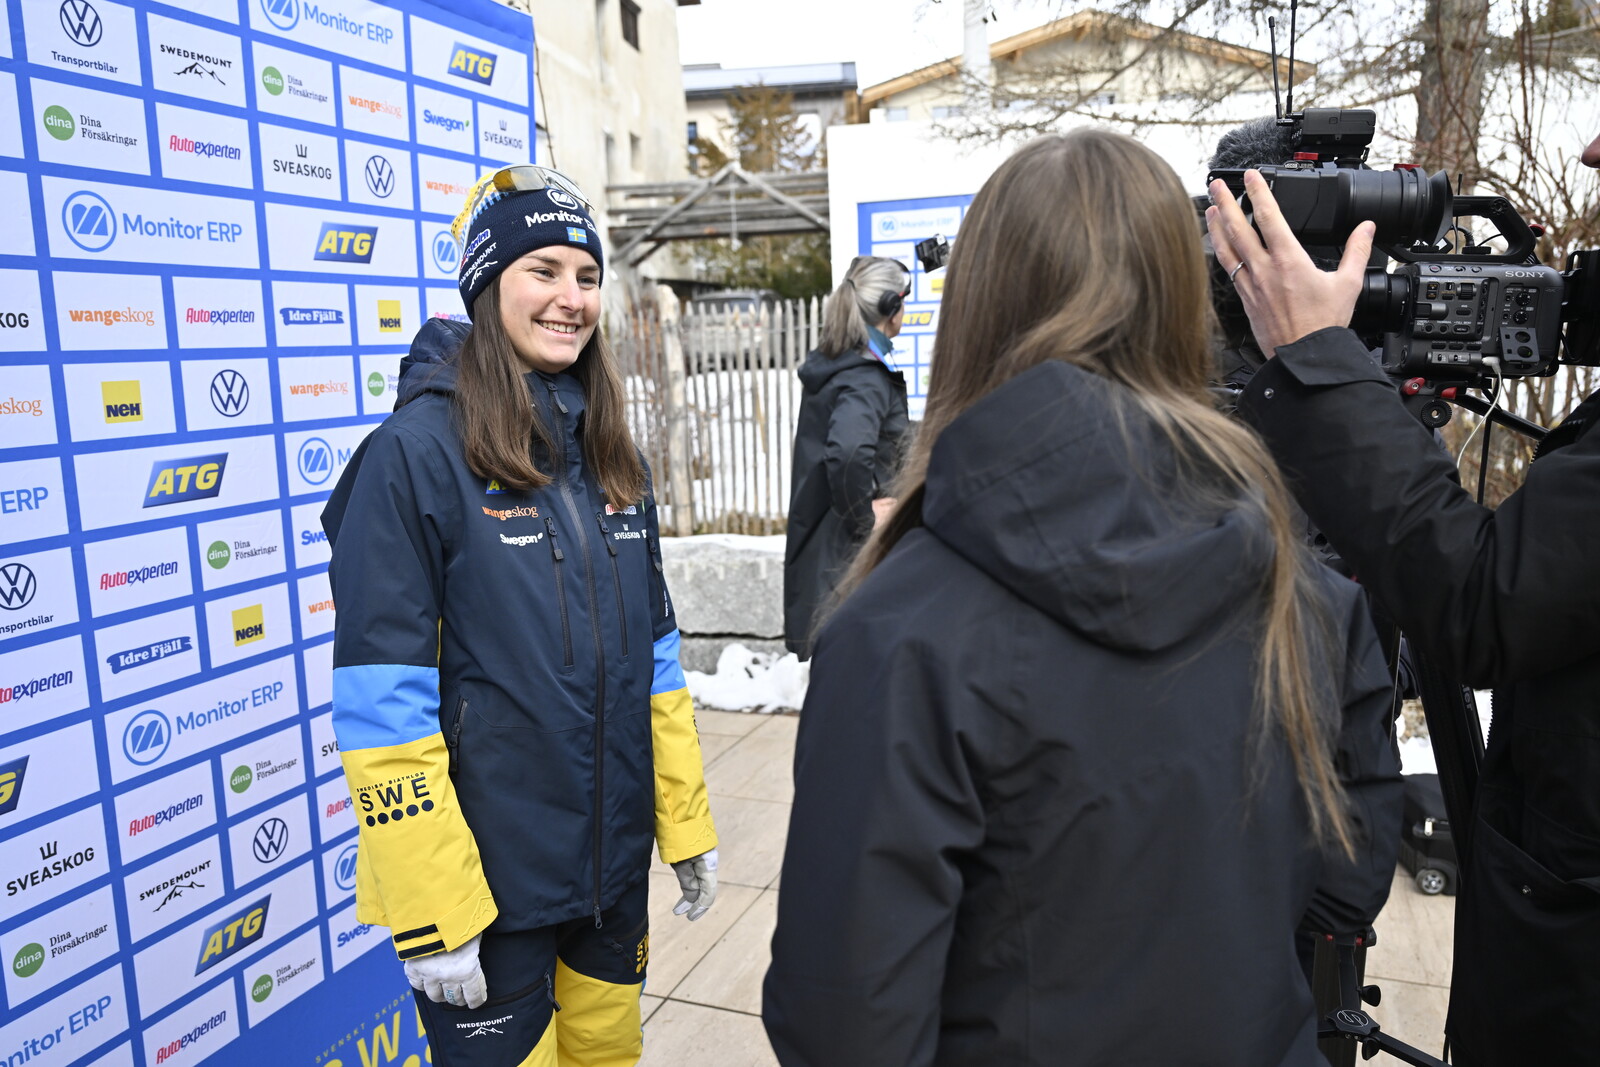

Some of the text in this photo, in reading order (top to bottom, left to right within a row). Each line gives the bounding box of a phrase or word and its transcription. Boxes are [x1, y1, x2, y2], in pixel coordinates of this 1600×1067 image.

[304, 5, 394, 46] Monitor ERP
[51, 50, 119, 74] Transportbilar
[160, 44, 232, 69] SWEDEMOUNT
[451, 50, 494, 80] ATG
[264, 74, 283, 87] dina
[287, 75, 303, 87] Dina
[288, 86, 328, 103] Försäkringar
[348, 94, 402, 119] wangeskog
[46, 115, 73, 130] dina
[80, 114, 102, 128] Dina
[423, 109, 465, 132] Swegon
[81, 128, 138, 147] Försäkringar
[170, 135, 241, 160] Autoexperten
[484, 131, 523, 150] SVEASKOG
[273, 159, 332, 180] SVEASKOG
[122, 213, 242, 243] Monitor ERP
[524, 210, 583, 228] Monitor
[318, 230, 372, 256] ATG
[1505, 270, 1545, 278] SONY
[69, 307, 155, 326] wangeskog
[186, 307, 255, 326] Autoexperten
[289, 310, 337, 323] Idre Fjäll
[289, 380, 348, 397] wangeskog
[149, 463, 219, 498] ATG
[0, 486, 49, 514] ERP
[482, 505, 539, 521] wangeskog
[234, 540, 251, 550] Dina
[500, 533, 539, 546] Swegon
[208, 549, 229, 561] dina
[235, 545, 278, 560] Försäkringar
[100, 561, 179, 591] Autoexperten
[119, 639, 182, 667] Idre Fjäll
[176, 681, 283, 735] Monitor ERP
[255, 759, 272, 771] Dina
[256, 758, 298, 781] Försäkringar
[231, 771, 251, 786] dina
[388, 771, 425, 785] BIATHLON
[359, 776, 430, 812] SWE
[129, 794, 203, 837] Autoexperten
[6, 847, 95, 897] SVEASKOG
[139, 860, 212, 902] SWEDEMOUNT
[49, 930, 72, 948] Dina
[50, 924, 108, 959] Försäkringar
[200, 907, 265, 965] ATG
[337, 924, 375, 948] Sweg
[15, 949, 43, 970] dina
[276, 963, 292, 978] Dina
[276, 958, 316, 987] Försäkringar
[252, 980, 273, 997] dina
[69, 995, 112, 1036] ERP
[156, 1010, 227, 1065] Autoexperten
[315, 1022, 366, 1064] SVENSKT
